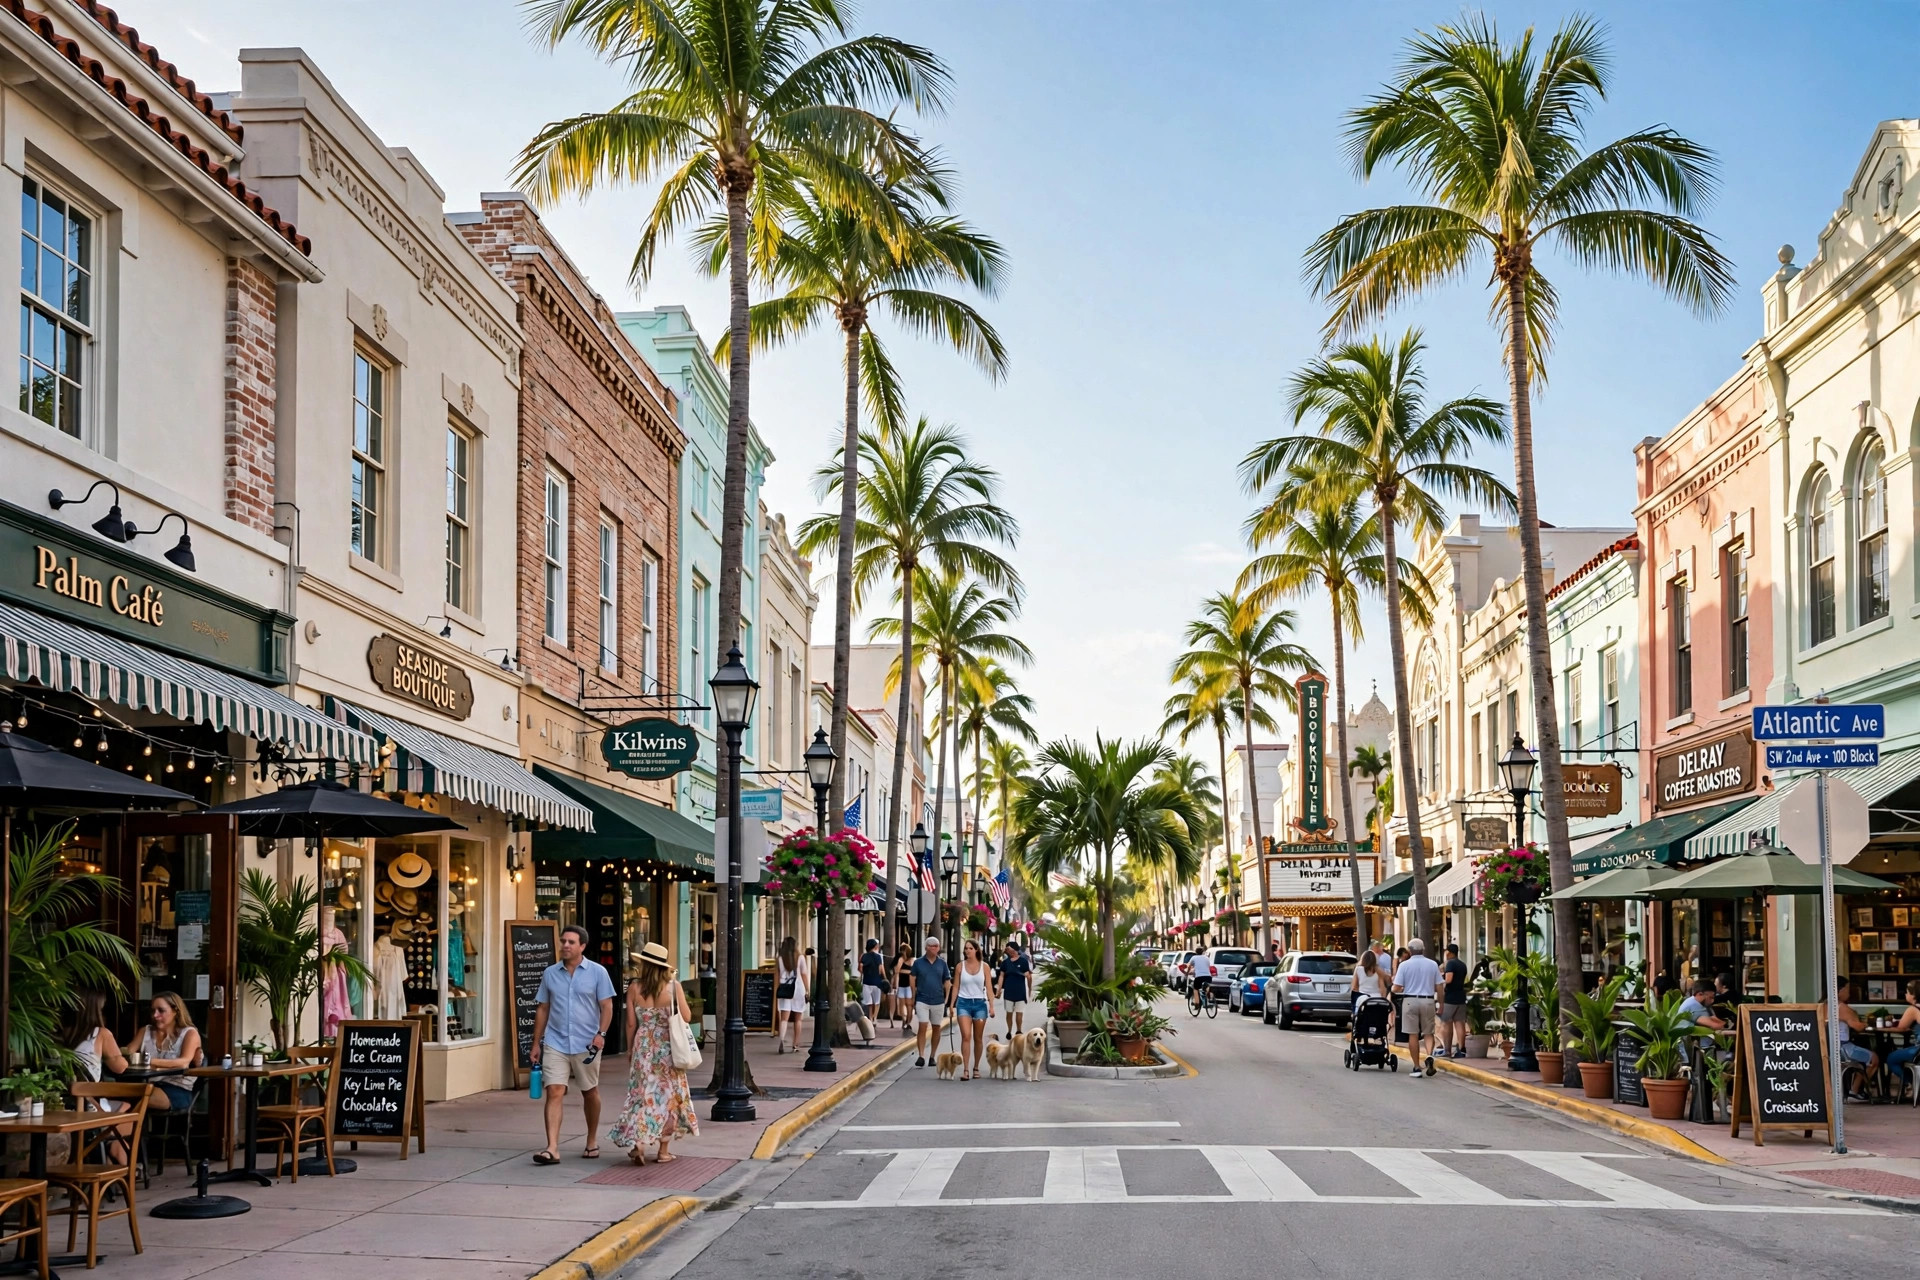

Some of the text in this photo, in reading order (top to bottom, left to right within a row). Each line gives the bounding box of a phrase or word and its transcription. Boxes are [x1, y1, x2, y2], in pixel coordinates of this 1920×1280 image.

[36, 545, 164, 627] Palm Café
[398, 645, 449, 685] SEASIDE
[393, 666, 456, 710] BOUTIQUE
[1760, 710, 1878, 735] Atlantic Ave
[612, 731, 688, 751] Kilwins
[1678, 742, 1726, 778] DELRAY
[1769, 748, 1875, 764] SW 2nd Ave 100 Block
[1664, 766, 1742, 802] COFFEE ROASTERS
[1756, 1017, 1811, 1032] Cold Brew
[349, 1032, 401, 1047] Homemade
[1761, 1036, 1809, 1056] Espresso
[349, 1048, 402, 1063] Ice Cream
[1763, 1055, 1810, 1071] Avocado
[344, 1076, 402, 1095] Key Lime Pie
[1767, 1077, 1799, 1092] Toast
[342, 1097, 398, 1112] Chocolates
[1763, 1099, 1819, 1114] Croissants
